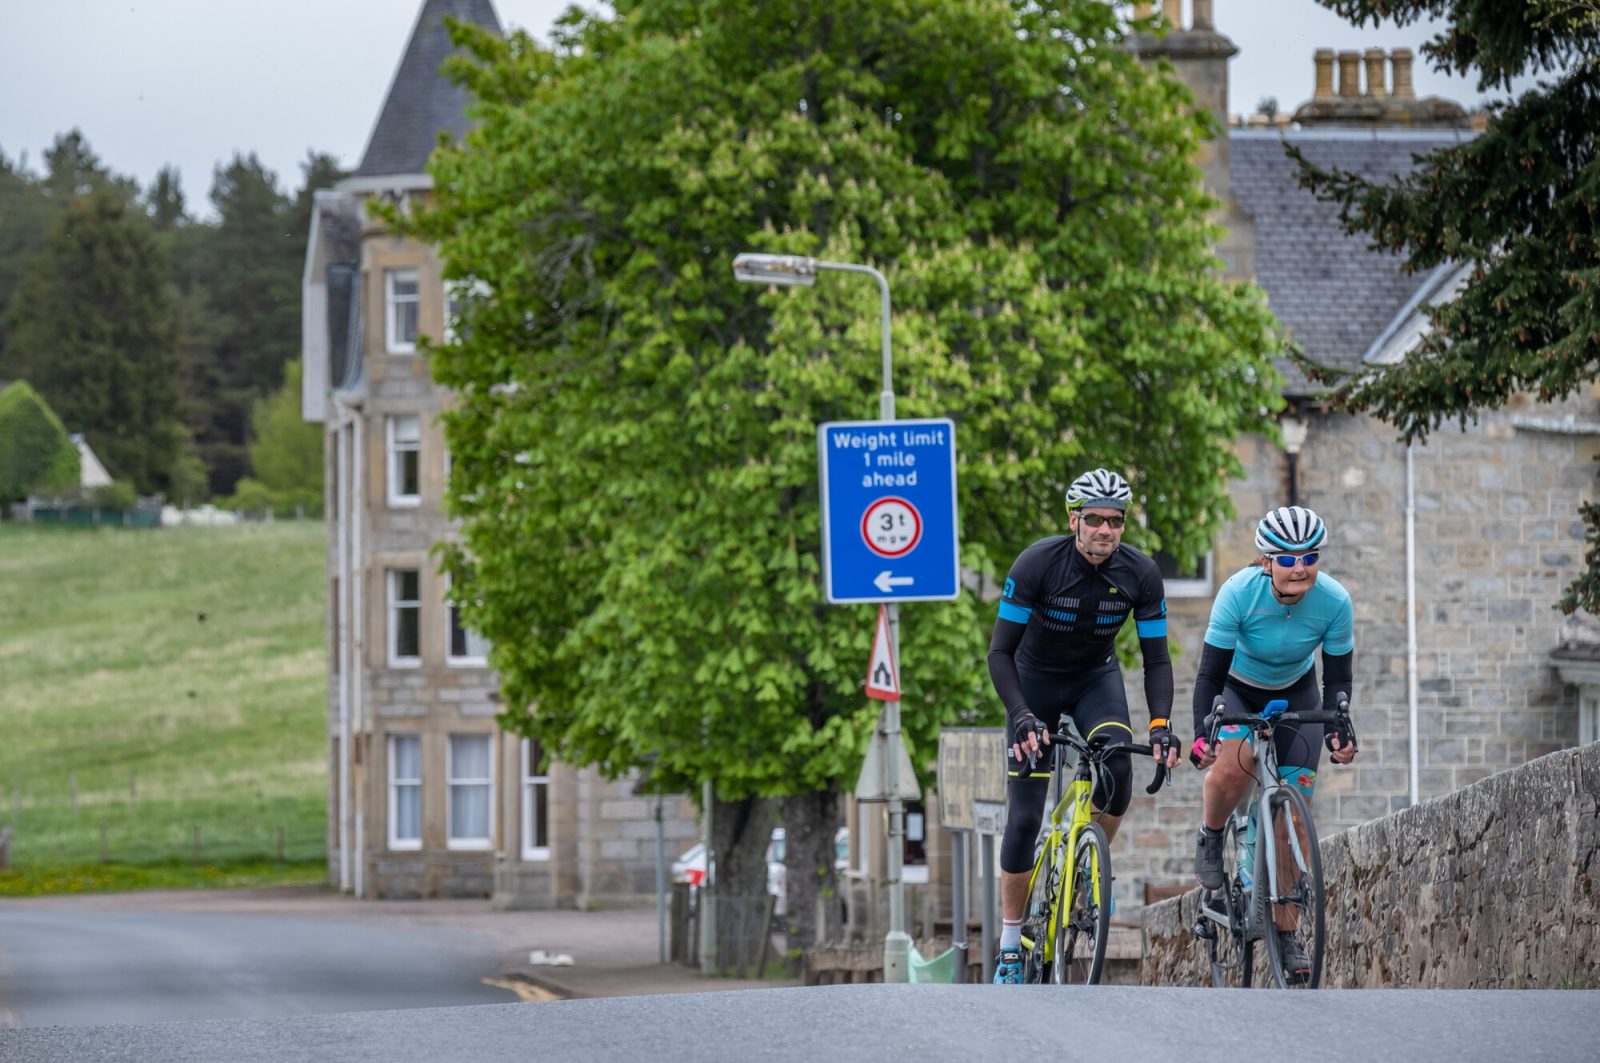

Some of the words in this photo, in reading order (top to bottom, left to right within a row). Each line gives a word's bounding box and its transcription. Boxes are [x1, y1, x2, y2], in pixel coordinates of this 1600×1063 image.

[833, 432, 897, 451] Weight
[903, 430, 944, 447] limit
[863, 452, 871, 467] 1
[877, 451, 915, 467] mile
[862, 470, 917, 488] ahead
